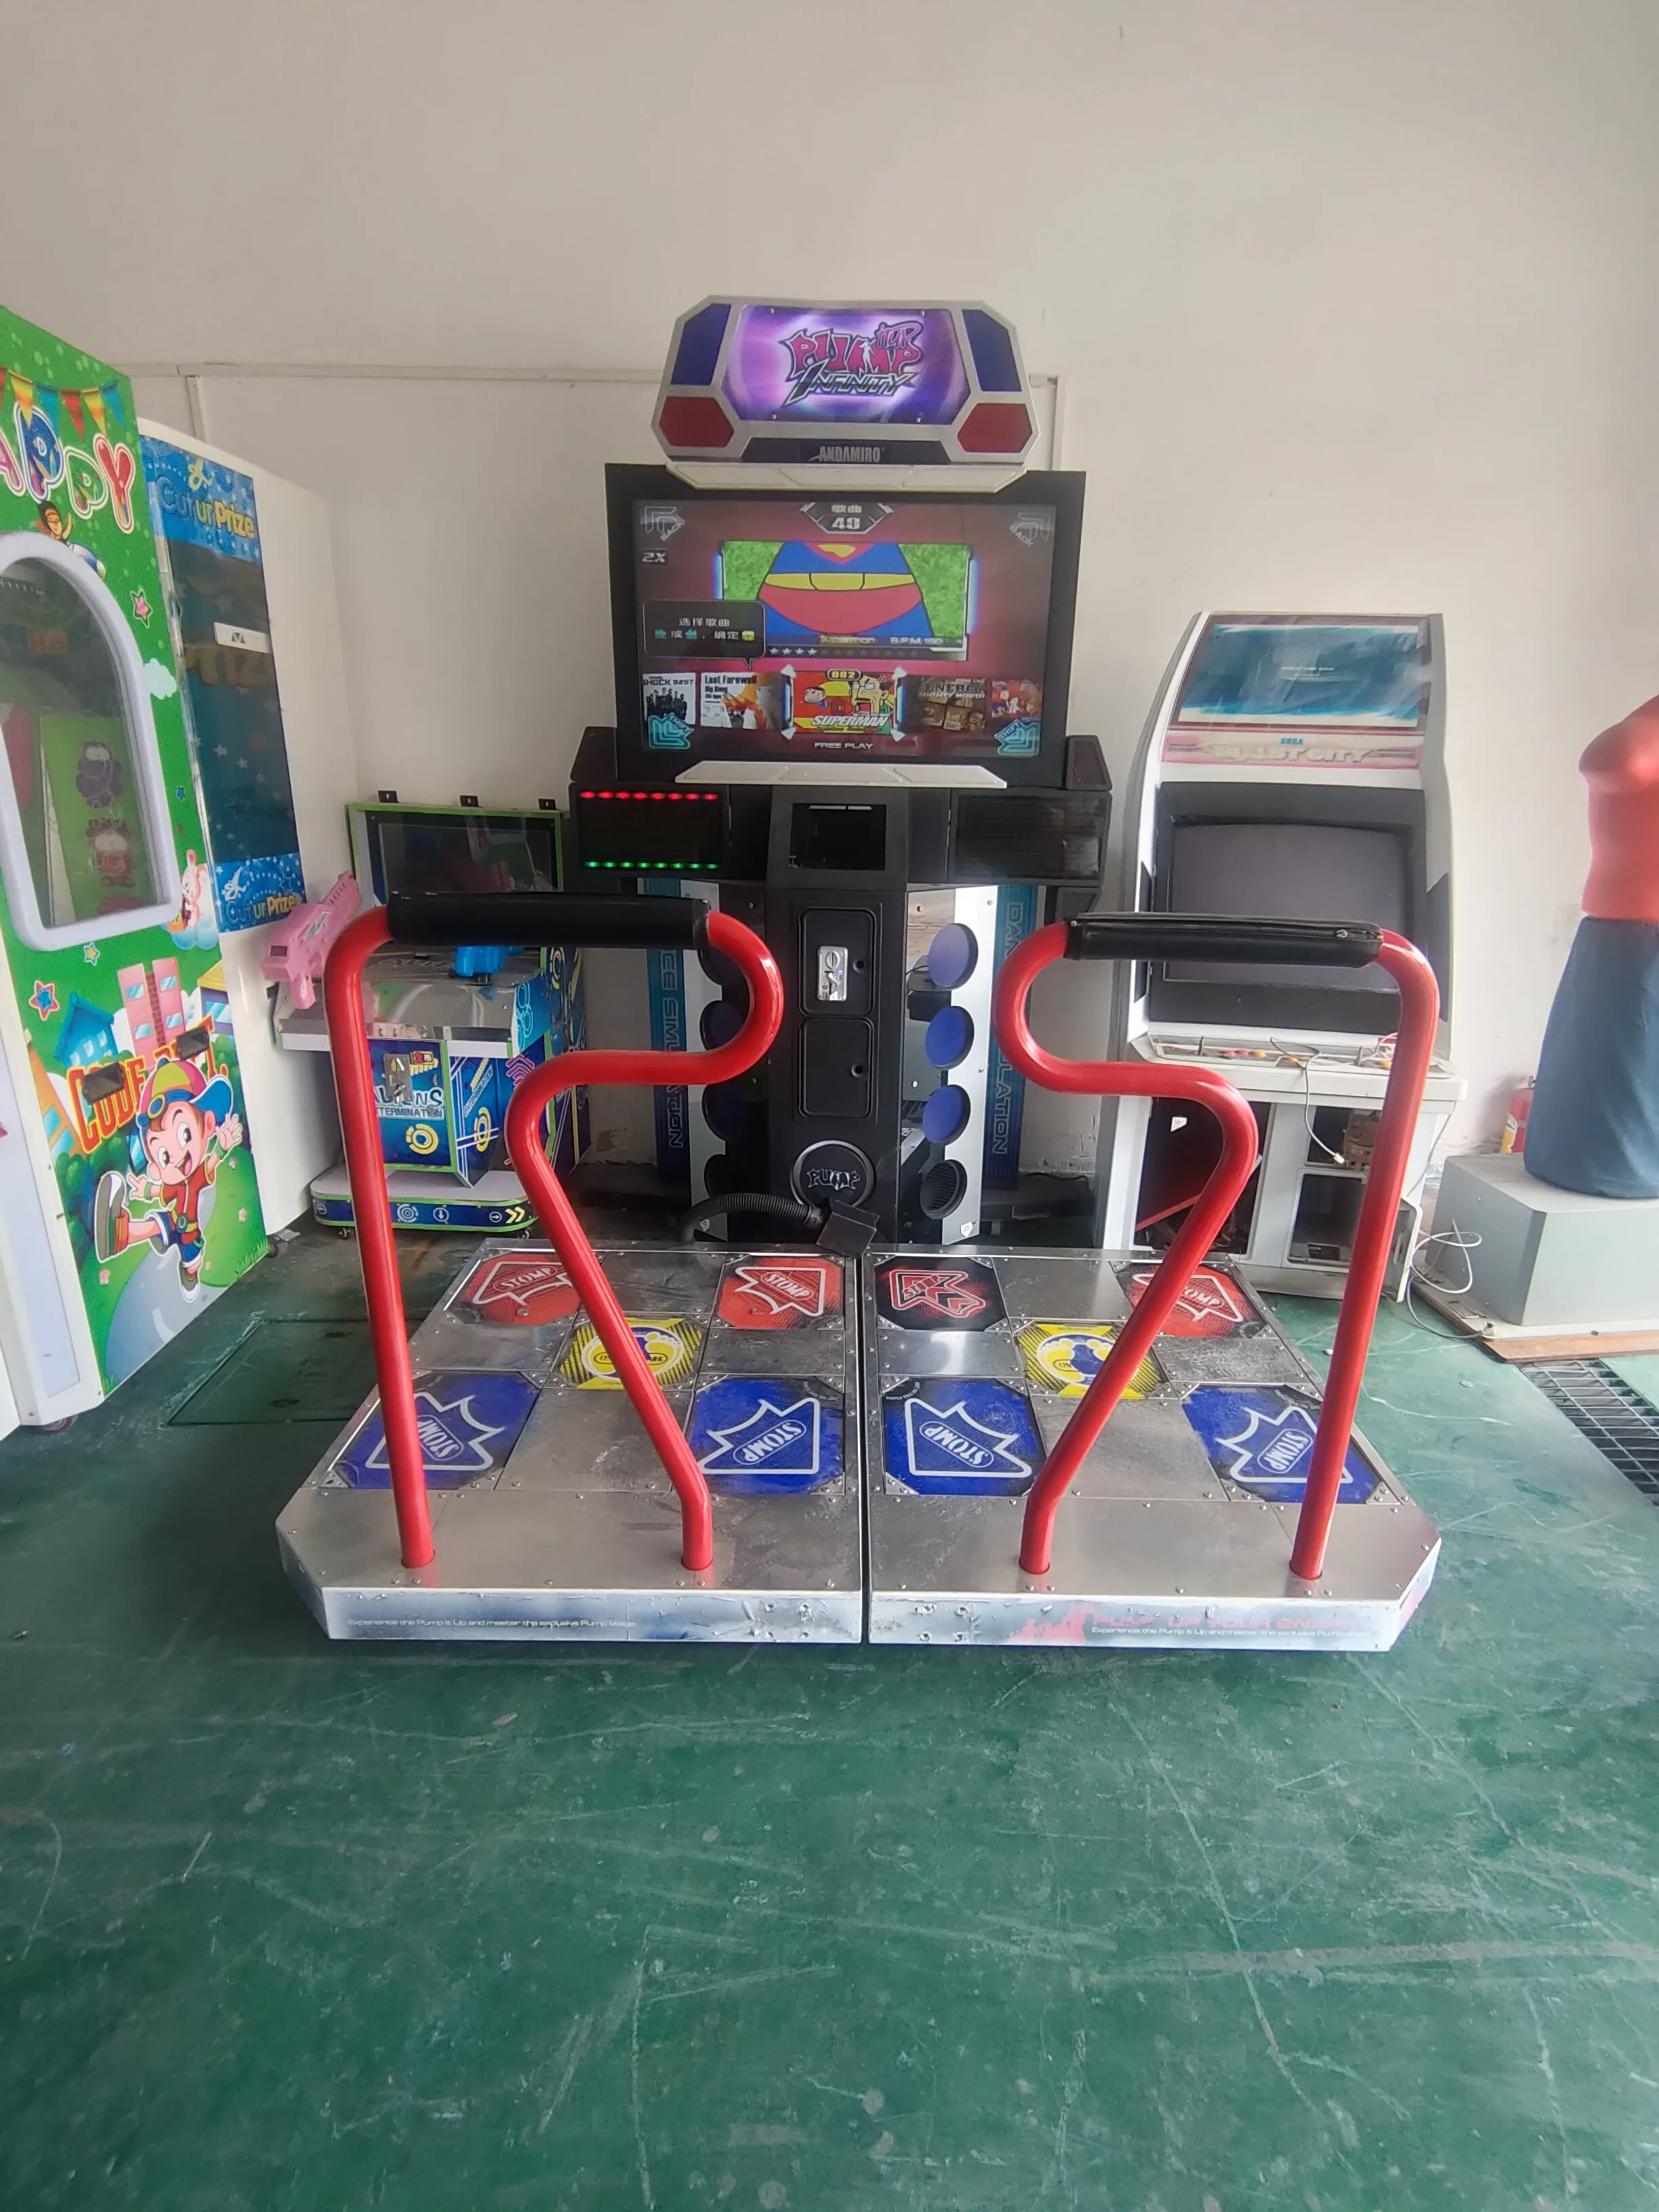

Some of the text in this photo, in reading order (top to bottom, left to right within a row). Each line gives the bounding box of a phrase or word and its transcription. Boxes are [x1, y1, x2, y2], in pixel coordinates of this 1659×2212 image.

[779, 329, 922, 382] PUMP
[784, 359, 916, 407] INFINITY
[819, 447, 881, 462] ANDAMIRO
[156, 476, 255, 541] Cut ur Prize
[642, 552, 666, 563] 2X
[679, 617, 730, 627] 选择歌曲
[705, 675, 757, 684] Last Farewell
[668, 714, 691, 734] SHIFT
[811, 714, 890, 727] SUPERMAN
[998, 720, 1021, 740] SHIFT
[1279, 737, 1304, 745] SEGA
[806, 1168, 861, 1191] PUMP
[500, 1267, 551, 1288] STOMP
[764, 1273, 811, 1297] STOMP
[742, 1422, 802, 1462] STOMP
[924, 1425, 989, 1465] STOMP
[1263, 1431, 1309, 1471] STOMP
